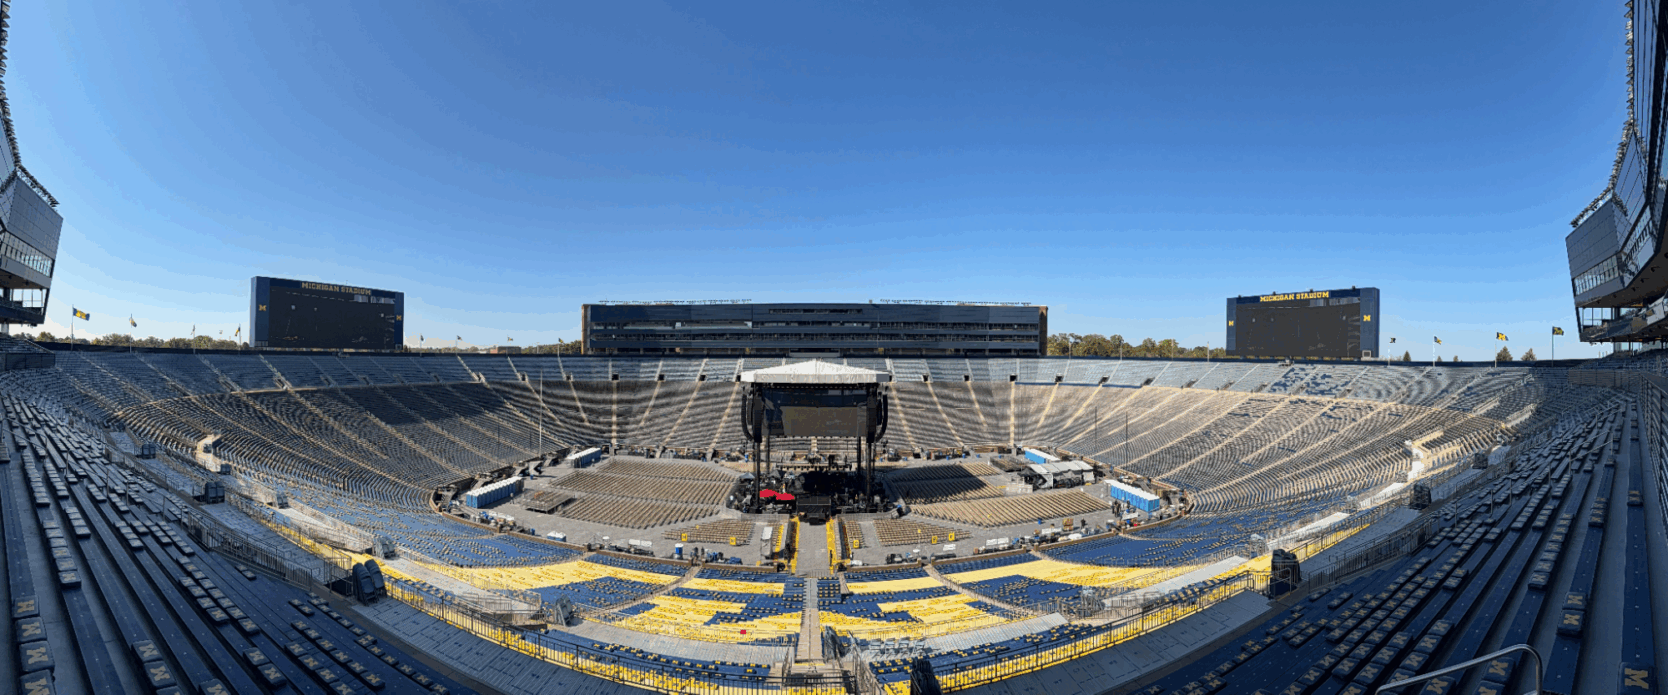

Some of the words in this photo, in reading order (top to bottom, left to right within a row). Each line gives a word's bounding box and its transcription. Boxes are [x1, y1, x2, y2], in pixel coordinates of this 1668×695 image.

[302, 282, 339, 292] MICHIGAN
[341, 286, 371, 295] STADIUM
[1260, 294, 1295, 302] MICHIGAN
[1296, 291, 1329, 300] STADIUM
[259, 304, 267, 312] M
